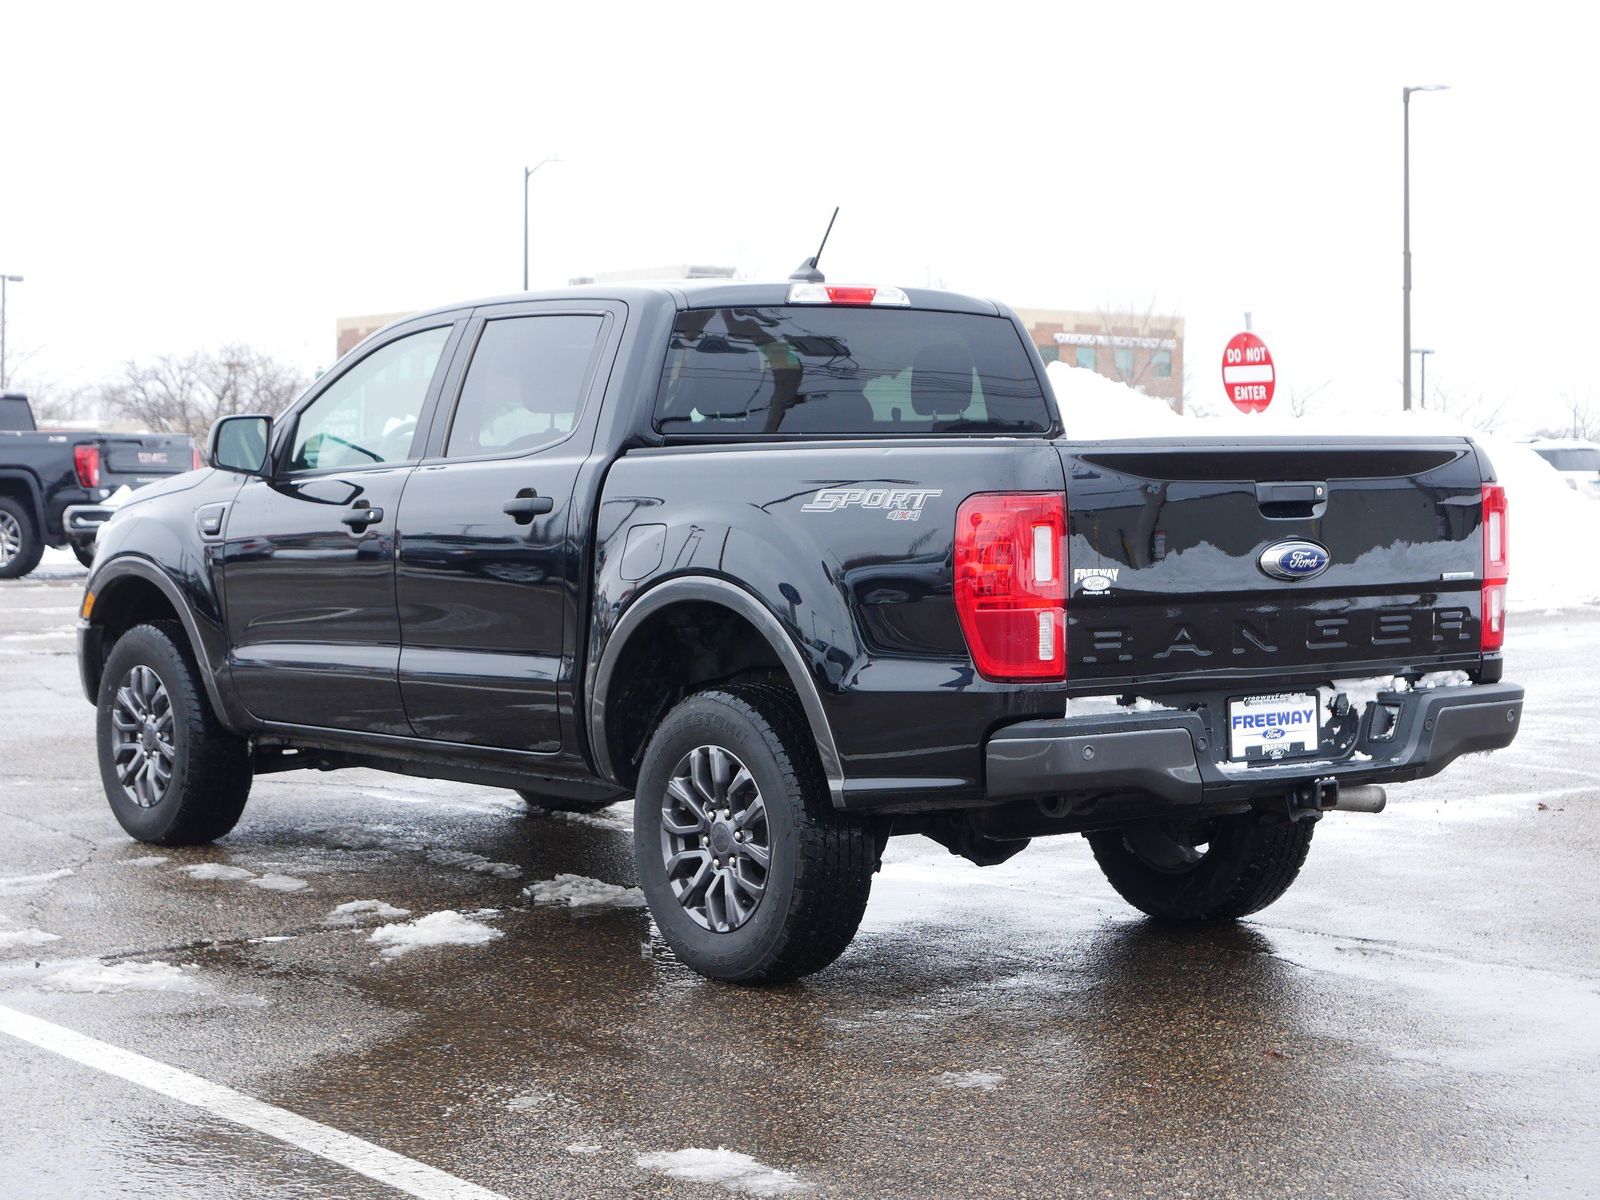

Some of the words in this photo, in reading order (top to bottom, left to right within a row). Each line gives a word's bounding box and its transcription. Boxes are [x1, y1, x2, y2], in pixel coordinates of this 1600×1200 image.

[1227, 348, 1241, 363] DO
[1246, 347, 1265, 362] NOT
[1234, 385, 1267, 401] ENTER
[138, 452, 168, 464] GMC
[801, 489, 943, 512] SPORT
[1290, 551, 1317, 568] Ford
[1074, 568, 1119, 584] FREEWAY
[1082, 607, 1472, 663] RANGER
[1232, 709, 1314, 730] FREEWAY
[1265, 729, 1282, 739] Ford
